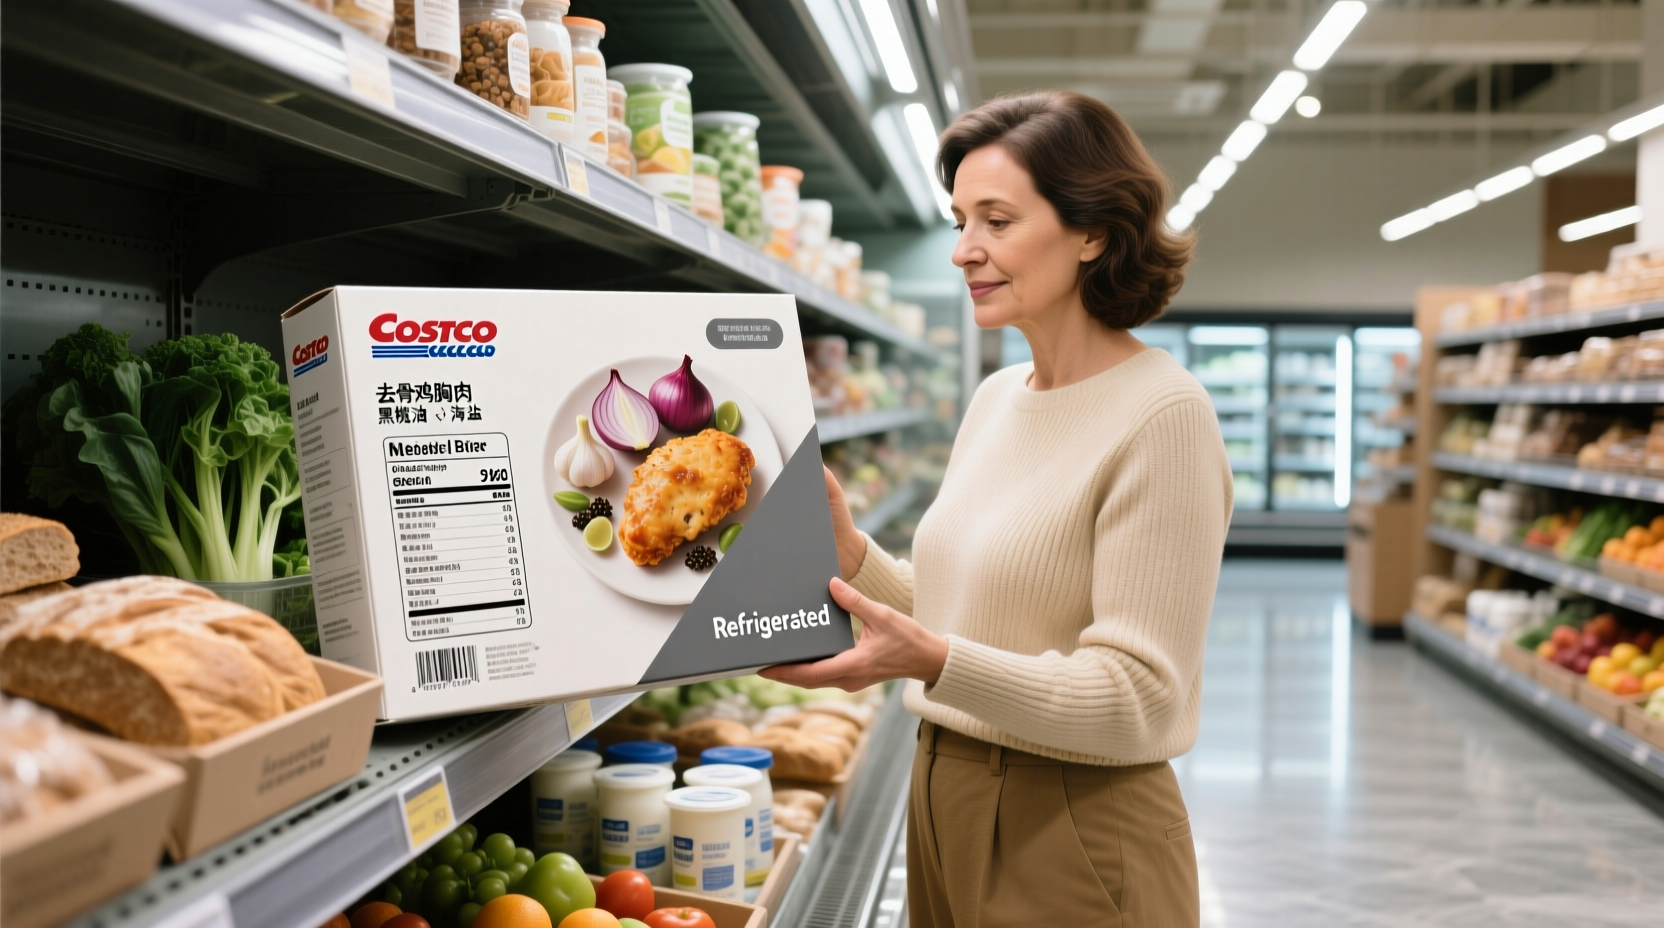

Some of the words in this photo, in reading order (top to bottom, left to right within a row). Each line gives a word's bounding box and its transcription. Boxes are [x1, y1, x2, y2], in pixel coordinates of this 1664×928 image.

[376, 381, 472, 403] 去骨鸡胸肉
[713, 604, 830, 639] Refrigerated
